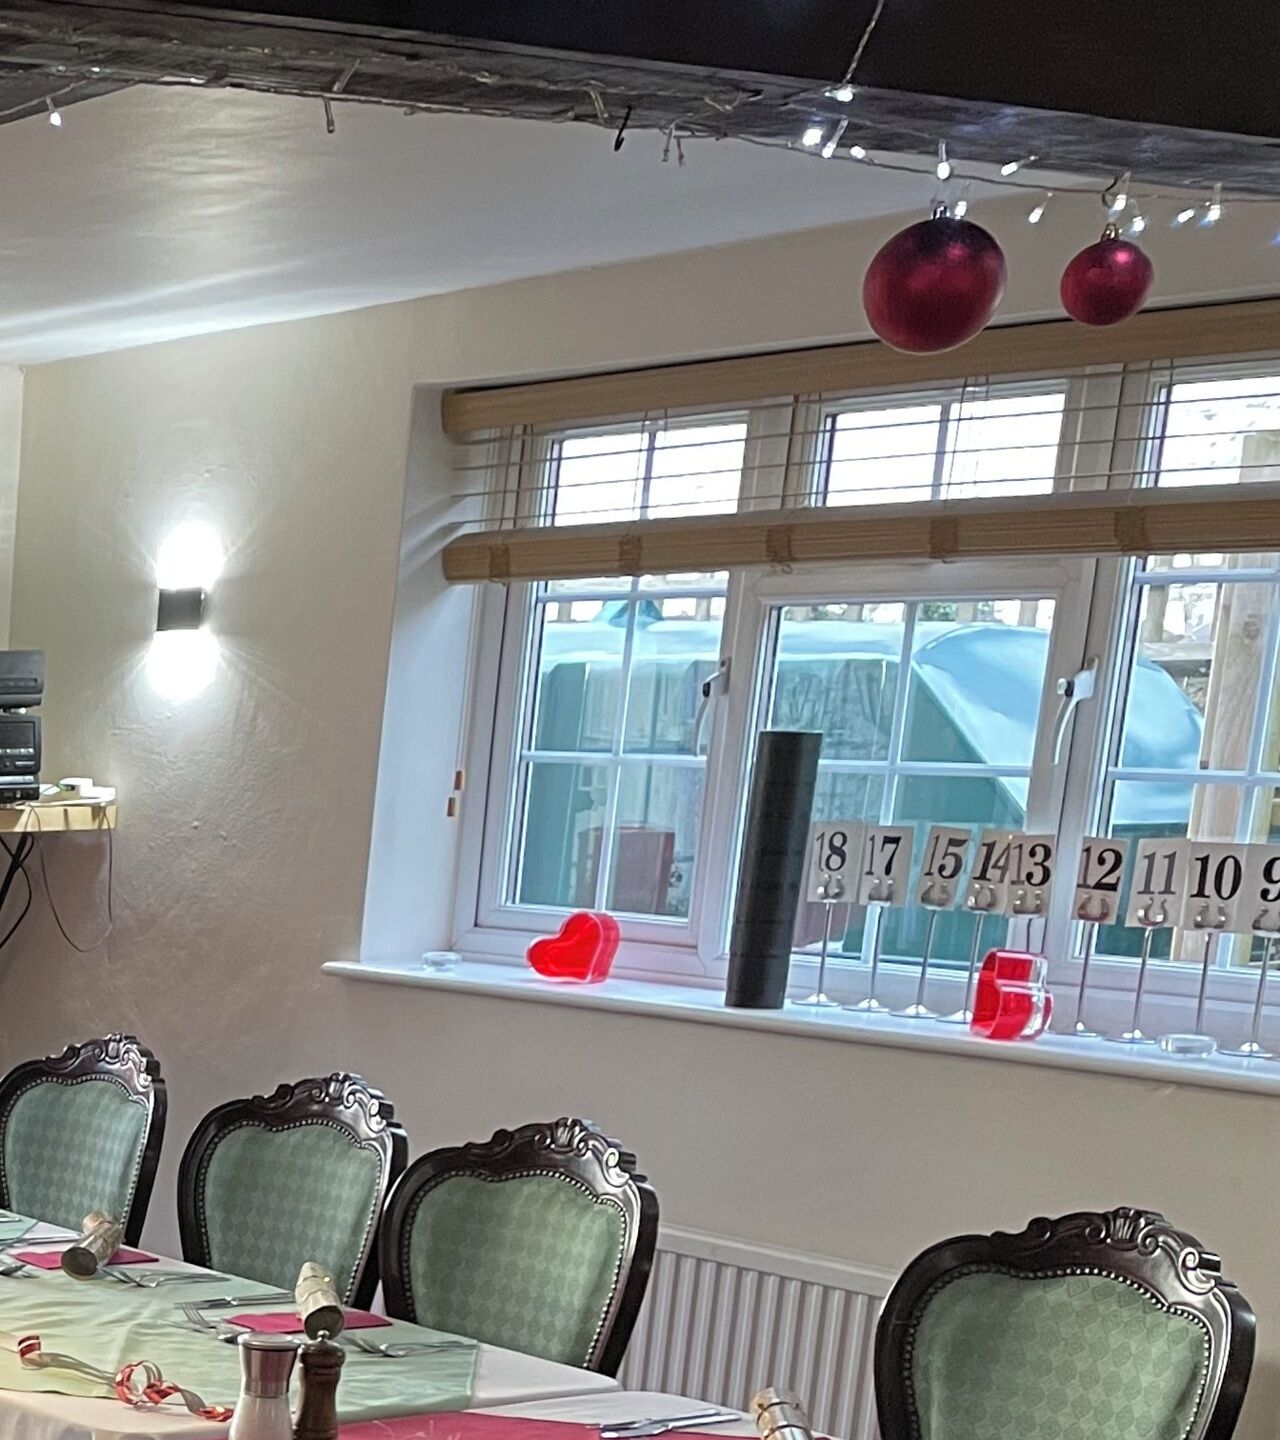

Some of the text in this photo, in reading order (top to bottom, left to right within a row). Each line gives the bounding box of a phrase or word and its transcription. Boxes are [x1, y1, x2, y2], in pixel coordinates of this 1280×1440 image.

[816, 831, 847, 872] 18
[865, 834, 902, 876] 17
[924, 834, 968, 879] 15
[972, 840, 1011, 883] 14
[1010, 843, 1052, 887] 13
[1076, 845, 1123, 892] 12
[1137, 851, 1177, 895] 11
[1190, 854, 1243, 901] 10
